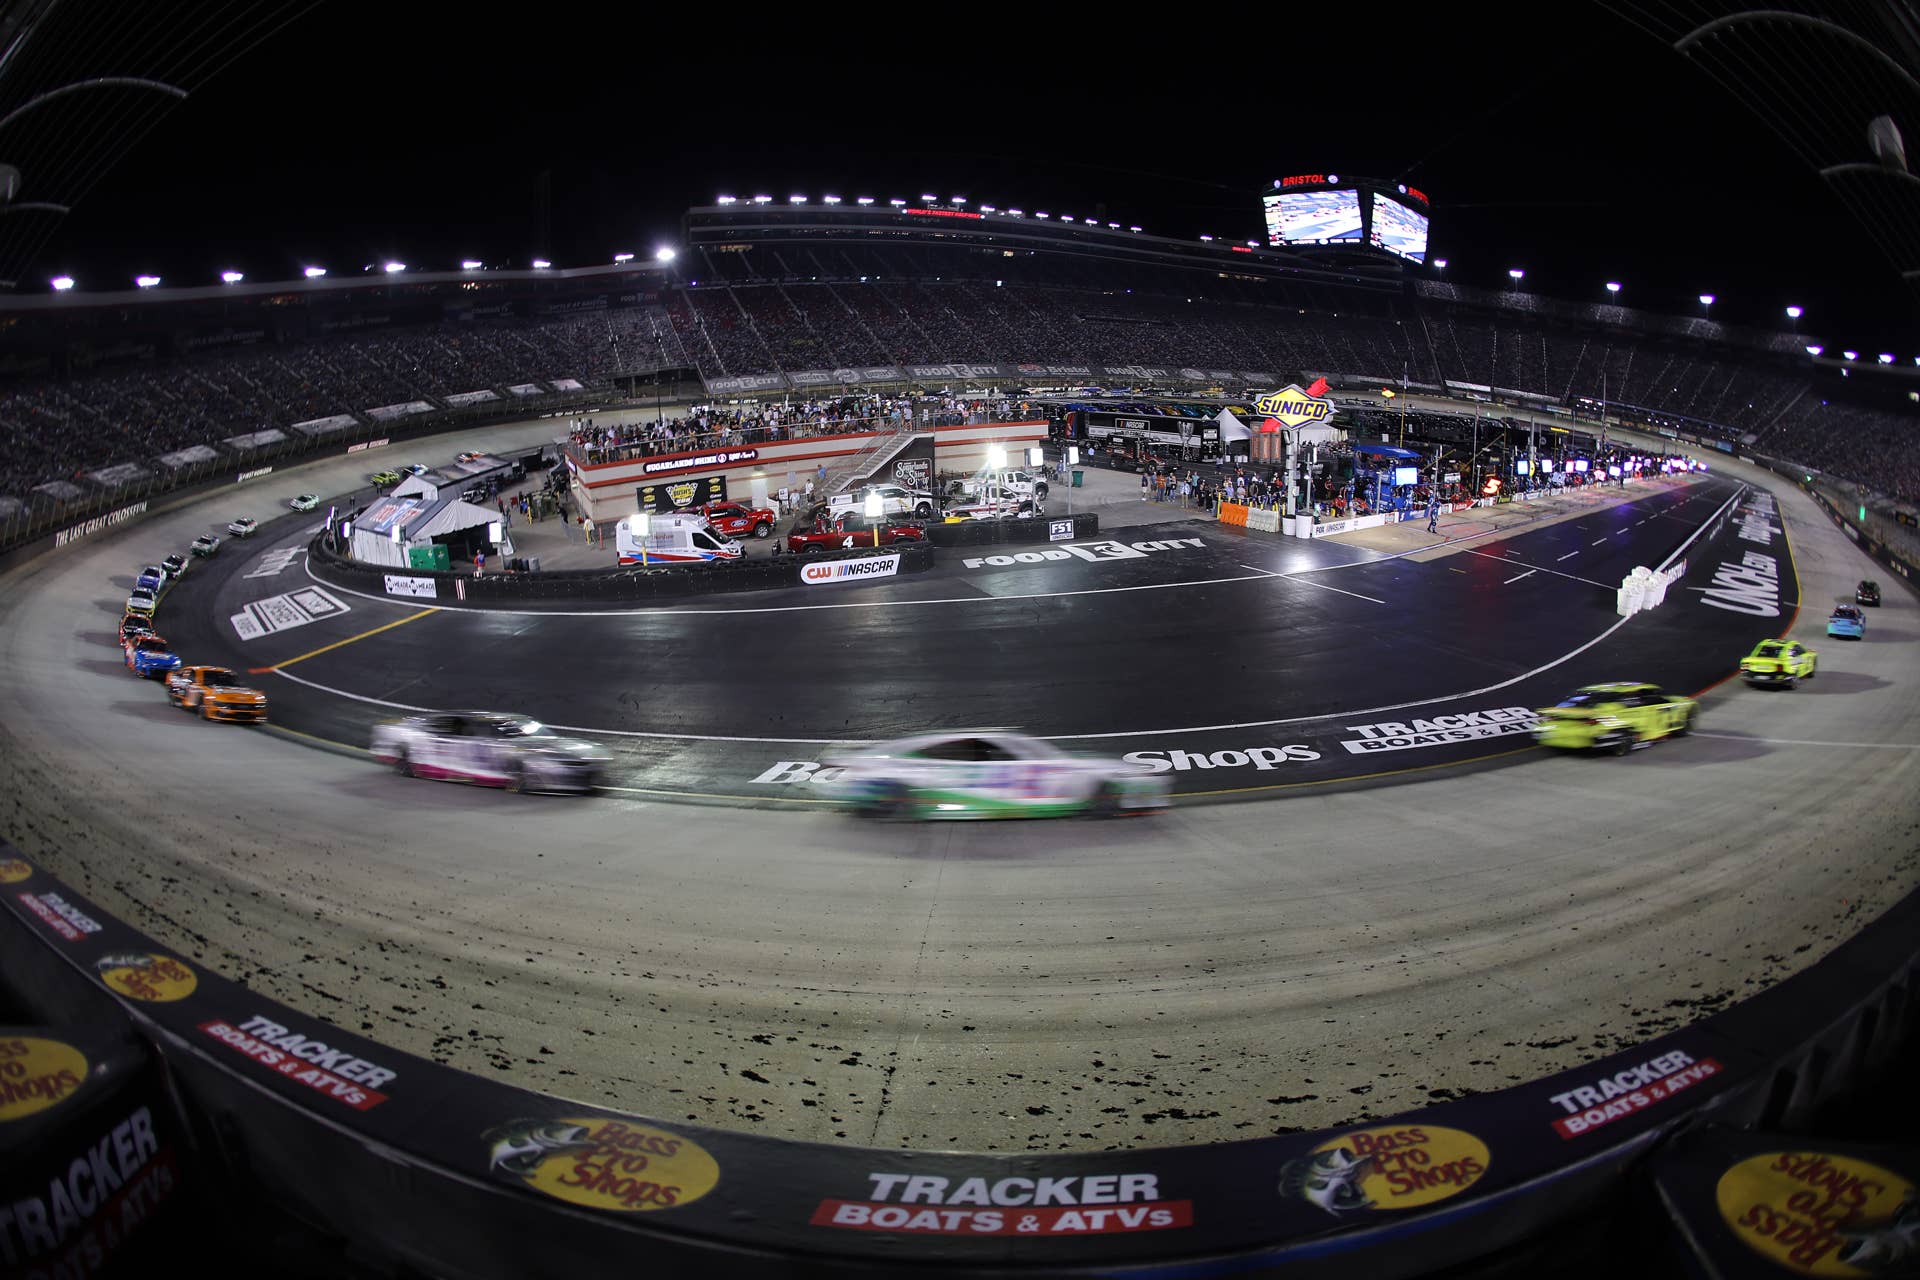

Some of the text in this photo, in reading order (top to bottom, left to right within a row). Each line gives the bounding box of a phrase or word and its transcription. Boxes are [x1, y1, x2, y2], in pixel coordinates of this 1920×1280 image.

[1283, 175, 1325, 186] BRISTOL
[710, 376, 779, 390] FOOD CITY
[914, 366, 999, 376] FOOD CITY
[1260, 399, 1326, 418] SUNOCO
[1125, 420, 1145, 430] NASCAR
[645, 457, 694, 472] SUGARLANDS
[1483, 478, 1501, 494] 5
[55, 528, 70, 549] THE
[69, 521, 86, 543] LAST
[85, 514, 108, 535] GREAT
[842, 535, 854, 549] 4
[1051, 523, 1073, 535] FS1
[963, 537, 1207, 569] FOOD CITY
[806, 559, 894, 579] CW NASCAR
[1346, 707, 1540, 740] TRACKER
[1357, 729, 1472, 751] BOATS
[1478, 728, 1494, 736] &
[747, 761, 848, 783] Ba
[1122, 743, 1321, 774] Shops
[207, 1023, 367, 1106] BOATS & ATVs
[238, 1015, 397, 1089] TRACKER
[1550, 1049, 1695, 1115] TRACKER
[1564, 1062, 1716, 1134] BOATS & ATVs
[593, 1121, 682, 1158] Bass
[1349, 1127, 1430, 1156] Bass
[573, 1144, 648, 1174] Pro
[1372, 1148, 1431, 1175] Pro
[0, 1105, 159, 1265] TRACKER
[557, 1162, 682, 1207] Shops
[867, 1173, 1159, 1206] TRACKER
[1388, 1154, 1484, 1199] Shops
[1770, 1153, 1886, 1209] Shops
[832, 1203, 1174, 1232] BOATS & ATVs
[1738, 1203, 1843, 1266] Bass
